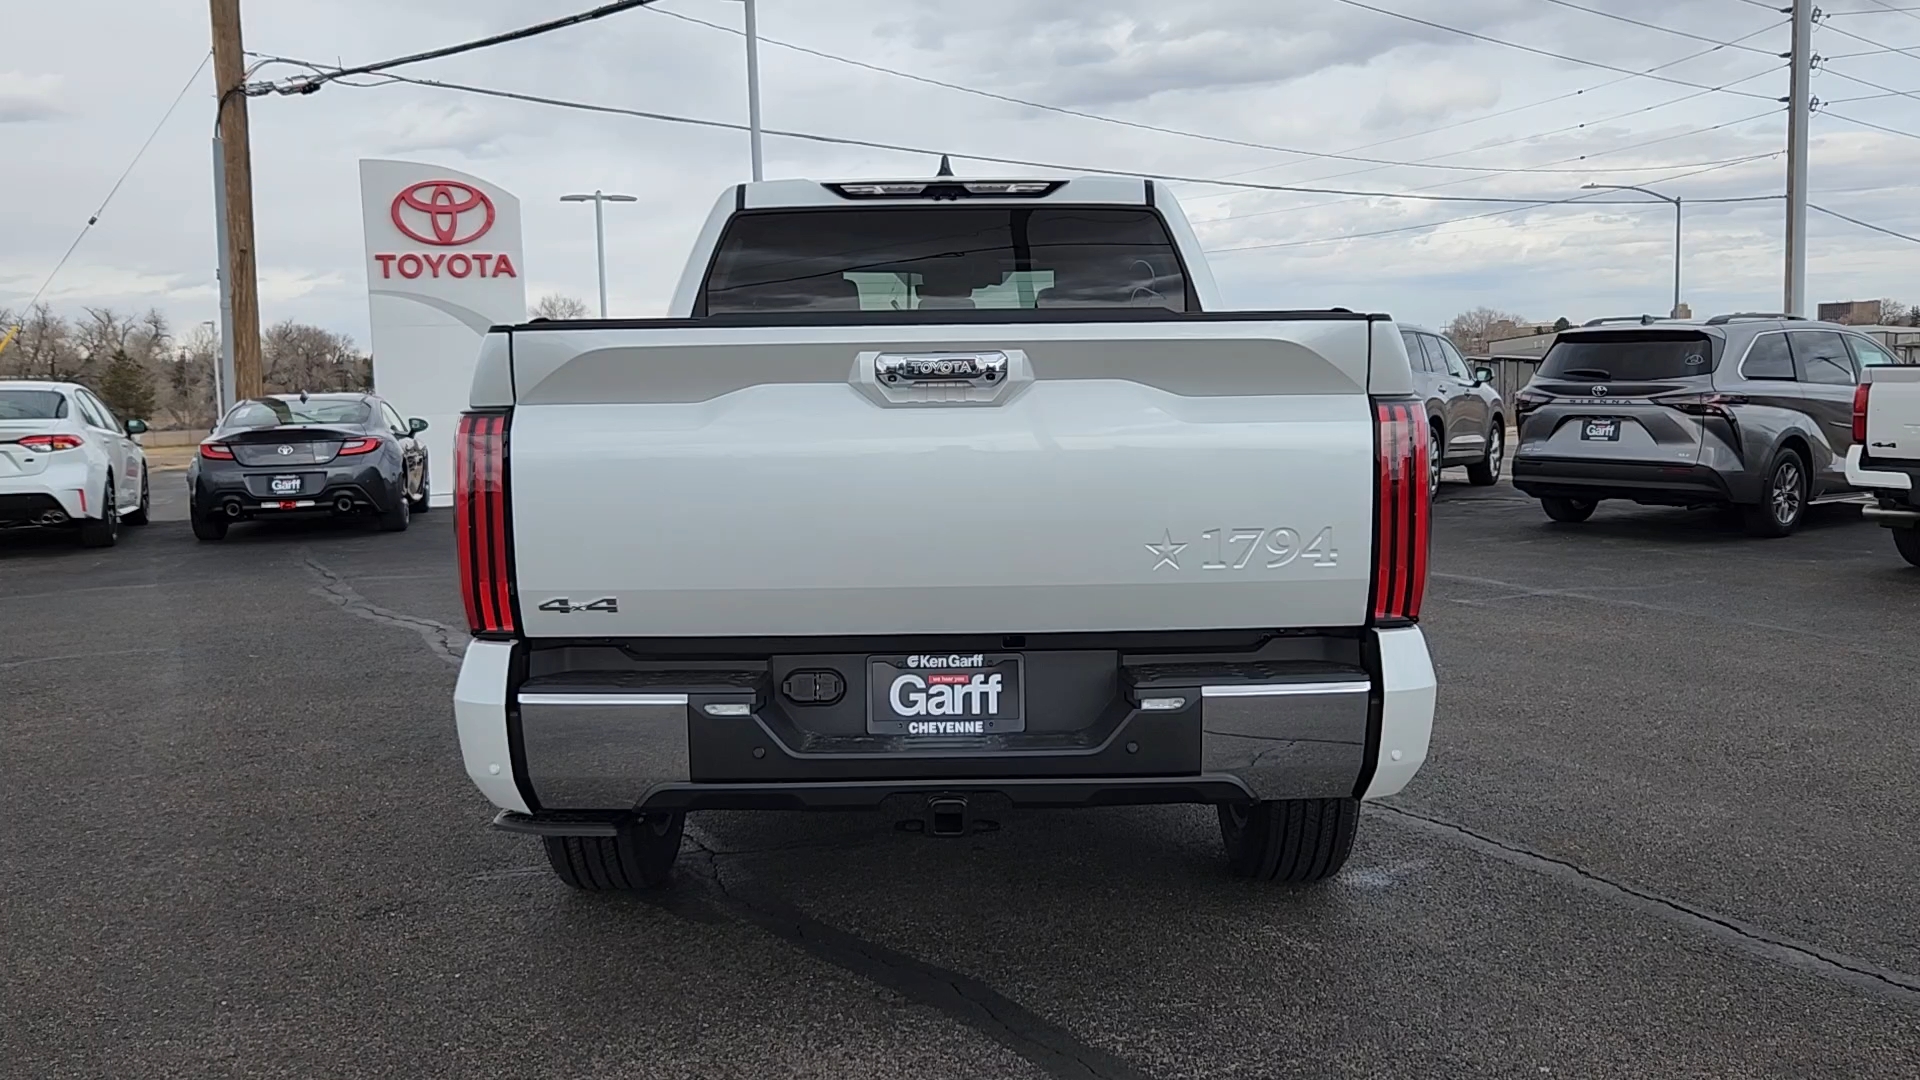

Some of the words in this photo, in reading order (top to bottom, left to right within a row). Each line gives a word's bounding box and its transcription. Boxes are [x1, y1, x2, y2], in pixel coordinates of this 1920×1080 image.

[375, 253, 517, 279] TOYOTA
[911, 360, 973, 374] TOYOTA
[1586, 424, 1615, 436] Garff
[271, 479, 301, 490] Garff
[1202, 526, 1338, 569] 1794
[538, 596, 618, 613] 4x4
[920, 654, 947, 668] Ken
[948, 654, 984, 668] Garff
[889, 673, 1002, 717] Garff
[908, 721, 984, 734] CHEYENNE
